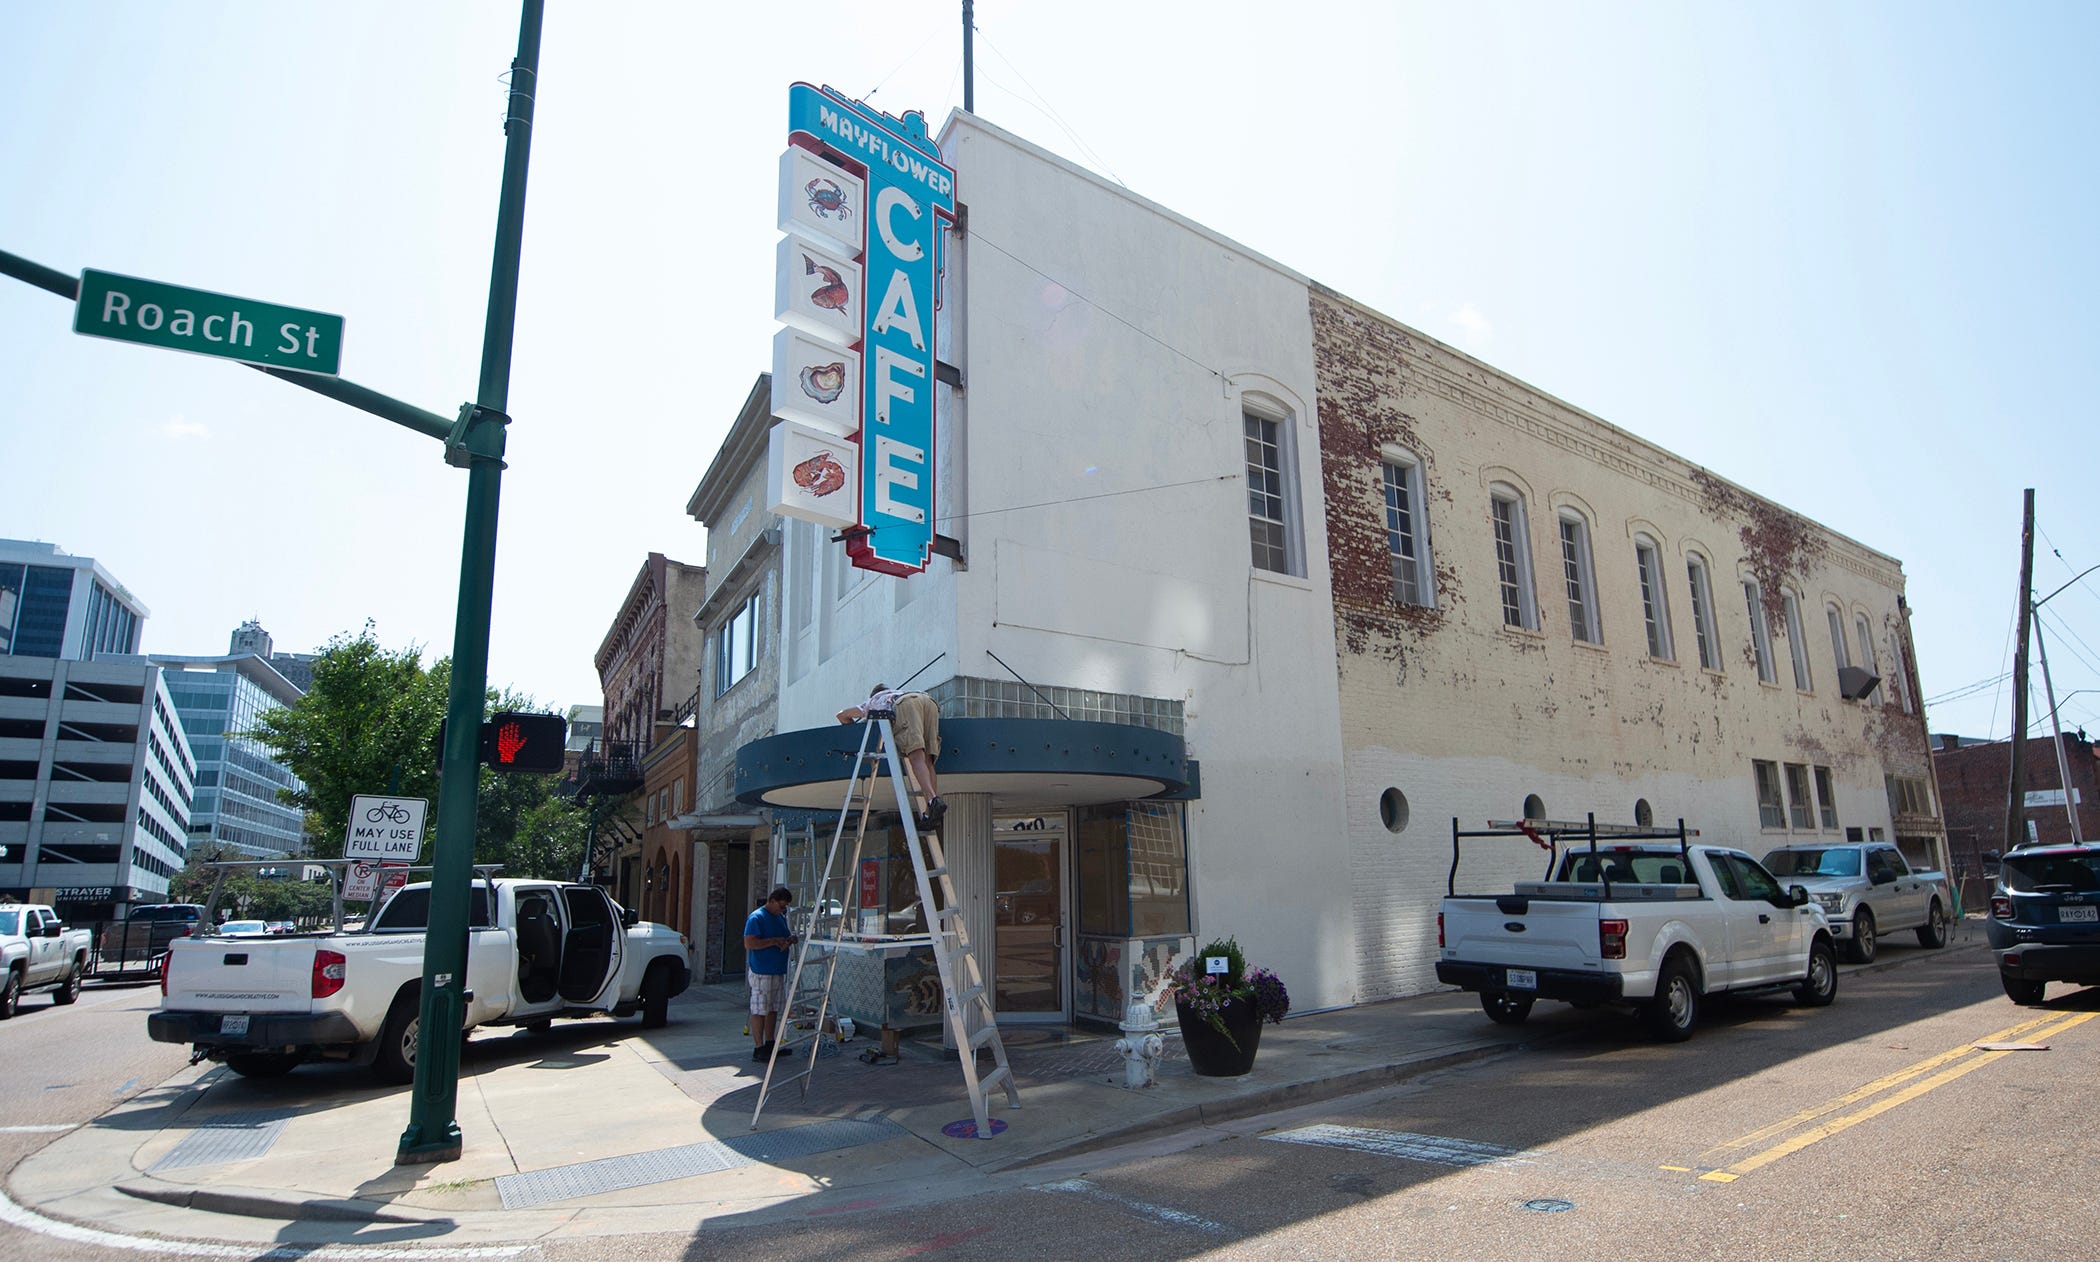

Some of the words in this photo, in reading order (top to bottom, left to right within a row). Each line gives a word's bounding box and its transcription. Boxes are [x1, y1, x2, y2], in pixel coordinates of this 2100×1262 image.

[820, 104, 952, 199] MAYFLOWER
[102, 290, 254, 347] Roach
[277, 323, 320, 358] St
[872, 185, 926, 525] CAFE
[352, 840, 380, 851] FULL
[385, 842, 413, 853] LANE
[355, 827, 384, 838] MAY
[390, 829, 415, 840] USE
[56, 887, 112, 896] STRAYER
